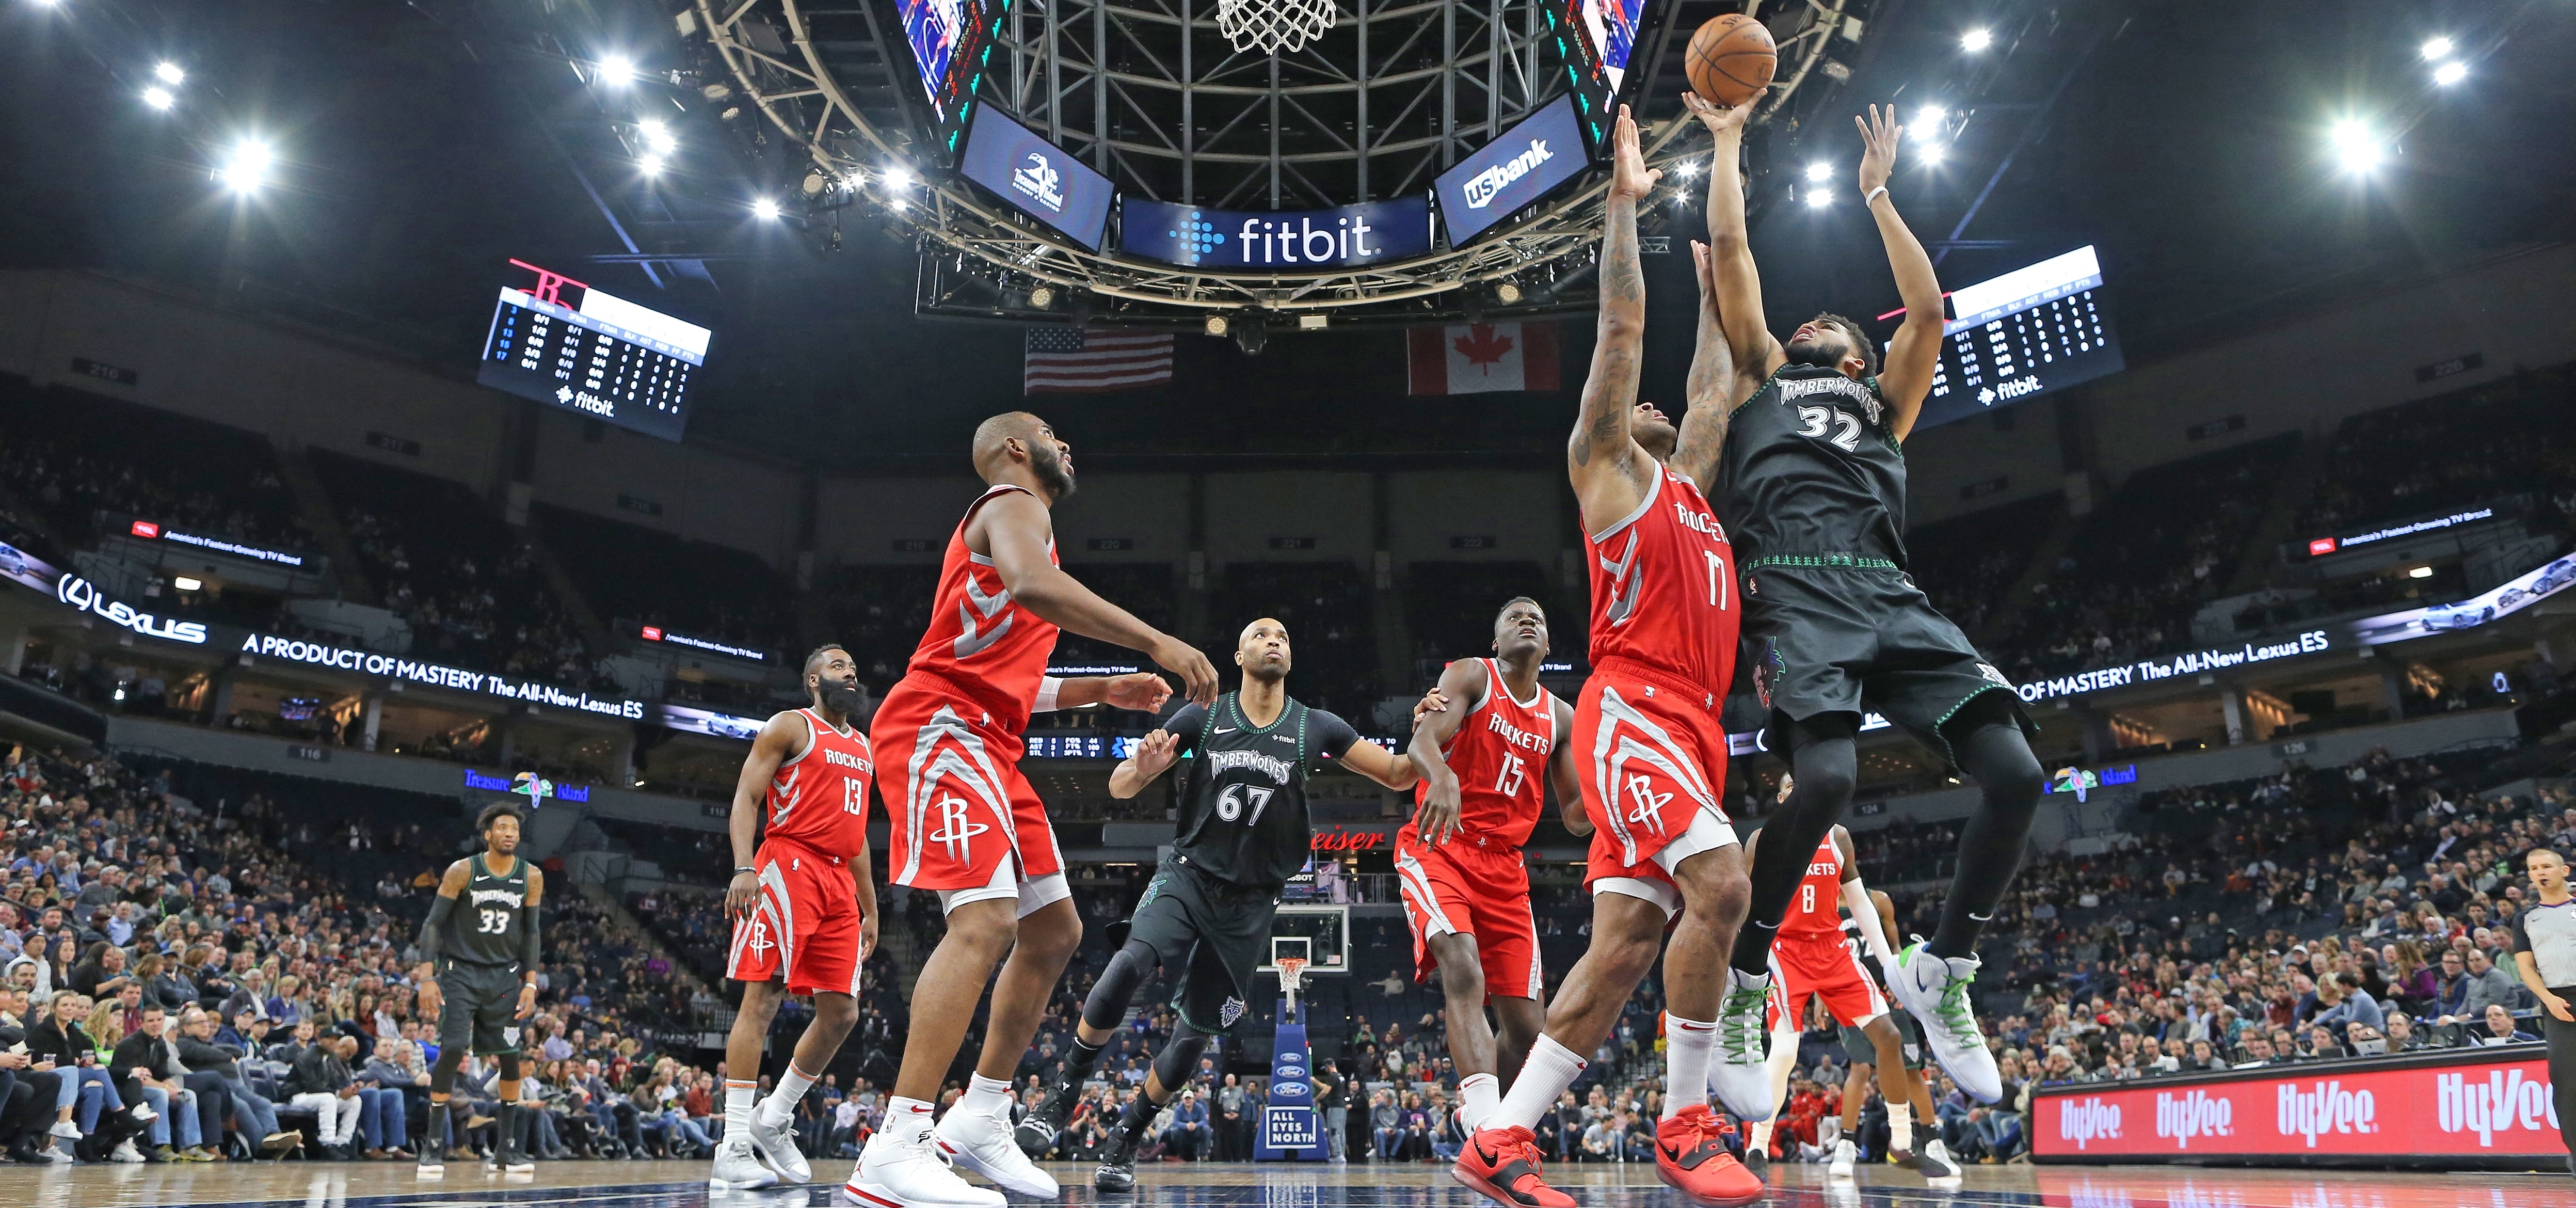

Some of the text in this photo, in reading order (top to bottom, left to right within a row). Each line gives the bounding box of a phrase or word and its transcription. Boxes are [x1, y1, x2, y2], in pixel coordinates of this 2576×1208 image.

[1239, 215, 1371, 263] fitbit
[574, 391, 614, 417] fitbit
[1774, 376, 1884, 425] TIMBERWOLVES
[1997, 374, 2042, 401] fitbit
[1796, 405, 1862, 452] 32
[1704, 549, 1727, 611] 17
[92, 593, 207, 644] LEXUS
[242, 634, 644, 719] A PRODUCT OF MASTERY The All-New Lexus ES
[2019, 630, 2329, 703] OF MASTERY The All-New Lexus ES
[1279, 734, 1296, 745] fitbit
[1488, 711, 1549, 755] ROCKETS
[824, 748, 873, 777] ROCKETS
[1206, 749, 1295, 785] TIMBERWOLVES
[1495, 751, 1524, 798] 15
[2101, 764, 2137, 786] Island
[465, 768, 589, 803] Treasure Island
[843, 775, 863, 816] 13
[1217, 783, 1275, 826] 67
[1310, 824, 1384, 850] eiser
[1806, 862, 1836, 876] KETS
[1802, 884, 1816, 914] 8
[477, 908, 511, 935] 33
[1272, 1111, 1294, 1121] ALL
[1272, 1122, 1302, 1132] EYES
[1272, 1133, 1316, 1143] NORTH
